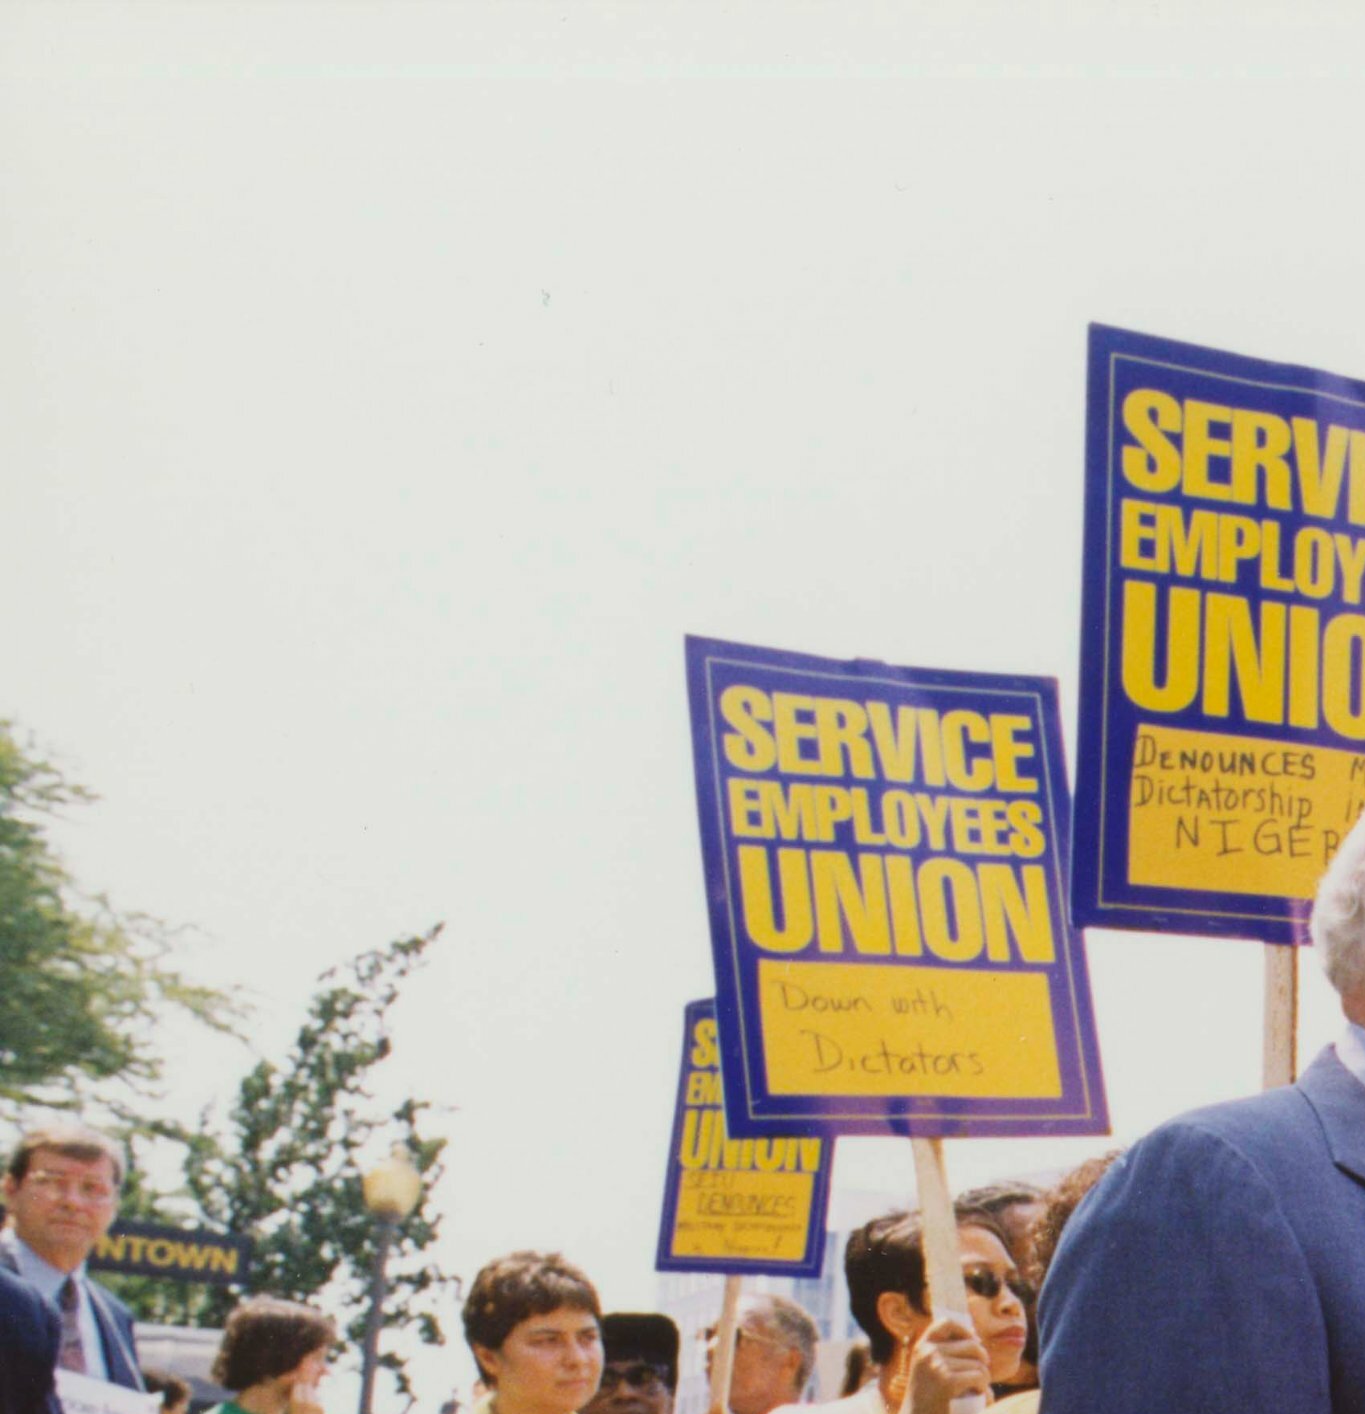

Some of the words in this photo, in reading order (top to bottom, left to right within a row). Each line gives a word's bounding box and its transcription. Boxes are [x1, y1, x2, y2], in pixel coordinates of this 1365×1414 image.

[720, 685, 1039, 793] SERVICE
[1134, 734, 1316, 780] DENOUNCES
[727, 777, 1047, 858] EMPLOYEES
[737, 844, 1056, 963] UNION
[770, 980, 873, 1012] Down
[892, 989, 954, 1021] with
[800, 1028, 984, 1076] Dictators
